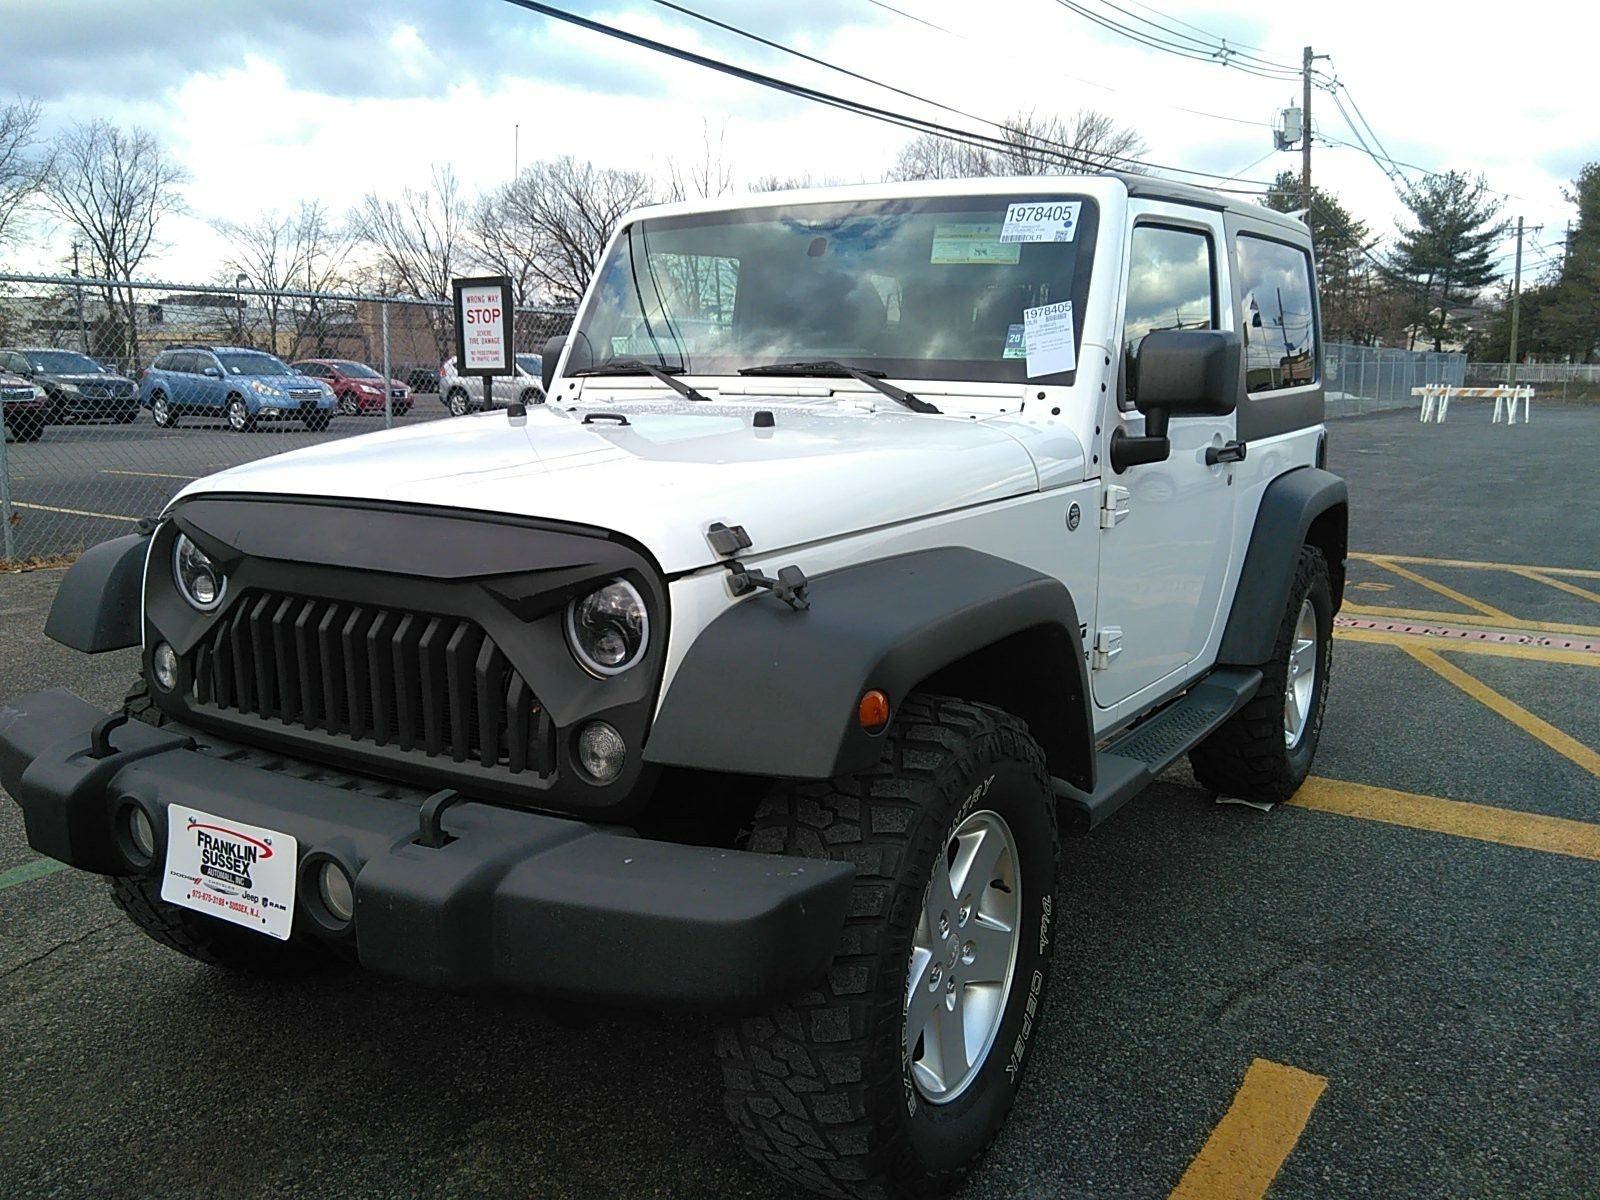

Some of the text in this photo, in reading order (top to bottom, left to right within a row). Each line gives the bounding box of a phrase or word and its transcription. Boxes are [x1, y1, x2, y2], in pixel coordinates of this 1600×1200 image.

[1009, 206, 1072, 222] 1978405
[466, 294, 498, 304] WRONG WAY
[467, 309, 501, 324] STOP
[1025, 302, 1072, 320] 1978405
[197, 830, 257, 863] FRANKLIN
[202, 849, 250, 878] SUSSEX
[170, 870, 195, 882] DODGE
[208, 880, 236, 890] CHRYSLER
[242, 891, 259, 904] Jeep
[269, 902, 286, 911] RAM
[1006, 970, 1042, 1084] CEPEK
